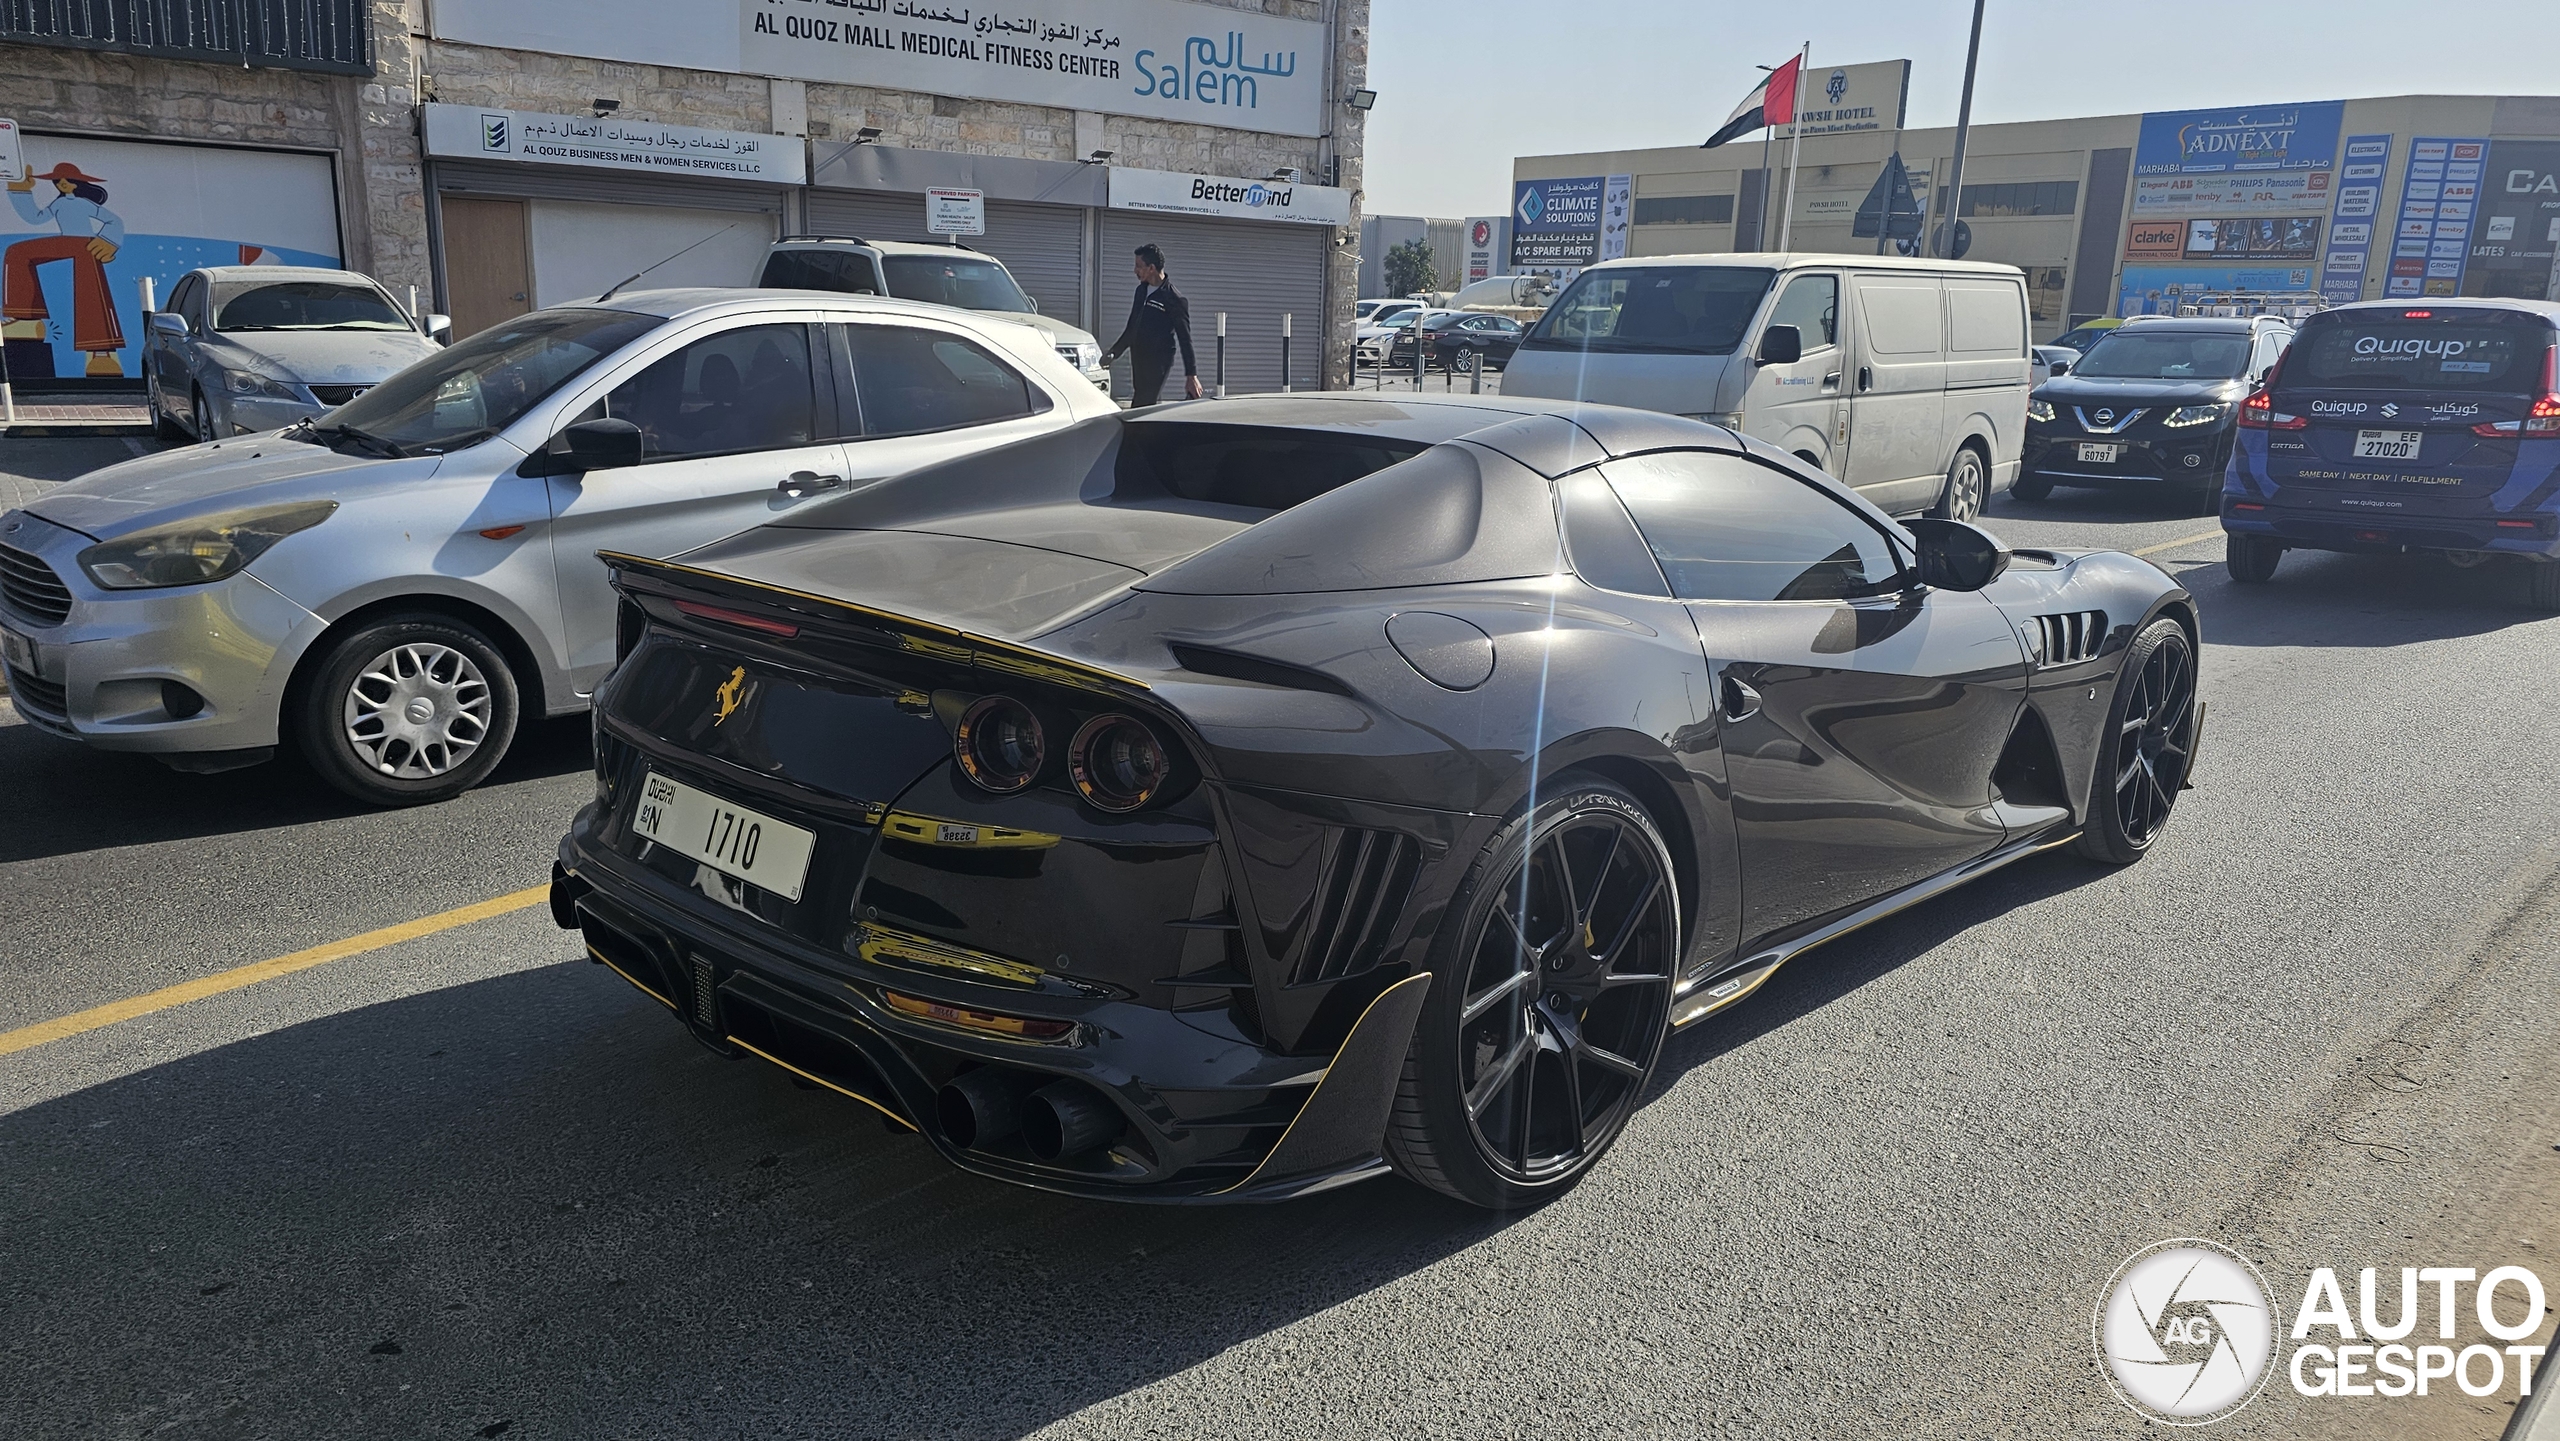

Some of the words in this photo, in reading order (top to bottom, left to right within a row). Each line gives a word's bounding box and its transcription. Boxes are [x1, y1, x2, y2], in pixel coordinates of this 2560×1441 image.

[974, 13, 1036, 38] التجاري
[1040, 23, 1079, 42] القوز
[754, 12, 779, 35] AL
[786, 15, 838, 42] QUOZ
[845, 23, 895, 50] MALL
[902, 31, 980, 61] MEDICAL
[986, 42, 1053, 71] FITNESS
[1059, 53, 1120, 80] CENTER
[1083, 28, 1120, 50] مركز
[1134, 36, 1257, 109] Salem
[1836, 107, 1876, 121] HOTEL
[656, 132, 686, 149] رجال
[690, 136, 730, 150] لخدمات
[734, 139, 759, 155] القوز
[523, 145, 537, 154] AL
[539, 146, 567, 157] QOUZ
[569, 149, 618, 161] BUSINESS
[620, 153, 642, 163] MEN
[644, 155, 652, 164] &
[653, 156, 690, 168] WOMEN
[692, 160, 737, 172] SERVICES
[738, 164, 761, 174] L.L.C
[2138, 164, 2180, 173] MARHABA
[2171, 180, 2193, 189] ABB
[2230, 179, 2264, 187] PHILIPS
[2266, 178, 2305, 187] Panasonic
[1547, 197, 1597, 211] CLIMATE
[2195, 193, 2221, 202] tenby
[1158, 204, 1188, 212] BUSINESSMEN
[1546, 212, 1596, 223] SOLUTIONS
[2135, 230, 2175, 244] clarke
[2438, 226, 2465, 234] tenby
[1515, 247, 1530, 256] A/C
[1532, 246, 1561, 256] SPARE
[1563, 246, 1593, 256] PARTS
[2472, 246, 2505, 257] LATES
[2324, 280, 2358, 289] MARHABA
[2427, 287, 2452, 295] JOTUN
[2324, 291, 2355, 301] LIGHTING
[2354, 336, 2464, 360] Quiqup
[2311, 400, 2367, 415] Quiqup
[2401, 432, 2418, 442] EE
[2084, 451, 2110, 461] 60797
[2365, 442, 2409, 457] 27020
[2401, 475, 2463, 485] FULFILLMENT
[2341, 499, 2403, 507] www.quiqup.com
[646, 805, 663, 836] N
[704, 808, 761, 871] 1710
